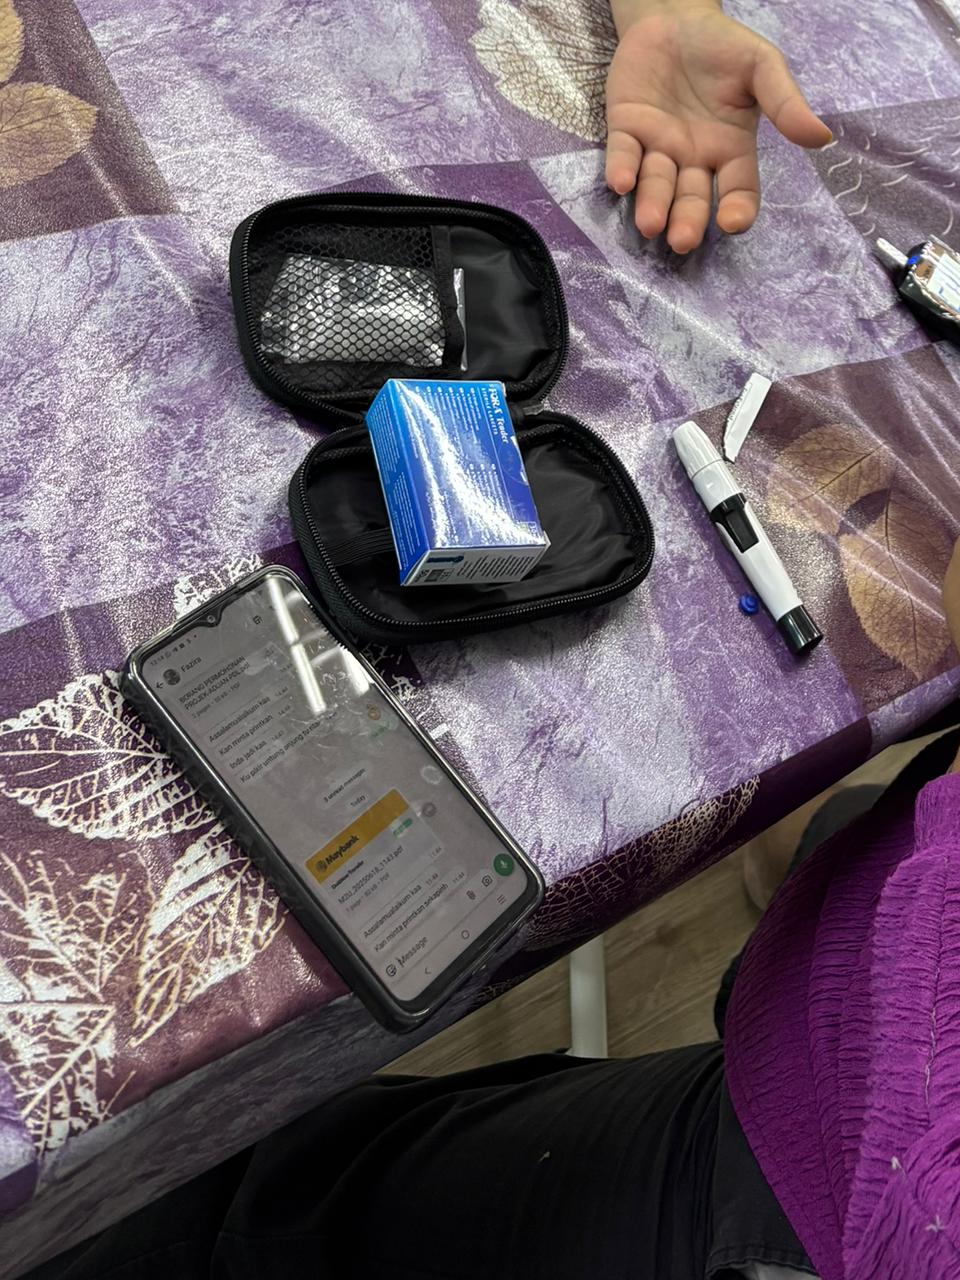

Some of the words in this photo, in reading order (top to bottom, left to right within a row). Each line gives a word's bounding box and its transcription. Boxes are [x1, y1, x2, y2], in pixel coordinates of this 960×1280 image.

[179, 654, 203, 673] Fazira
[324, 833, 360, 865] Maybank
[398, 935, 429, 964] Message
